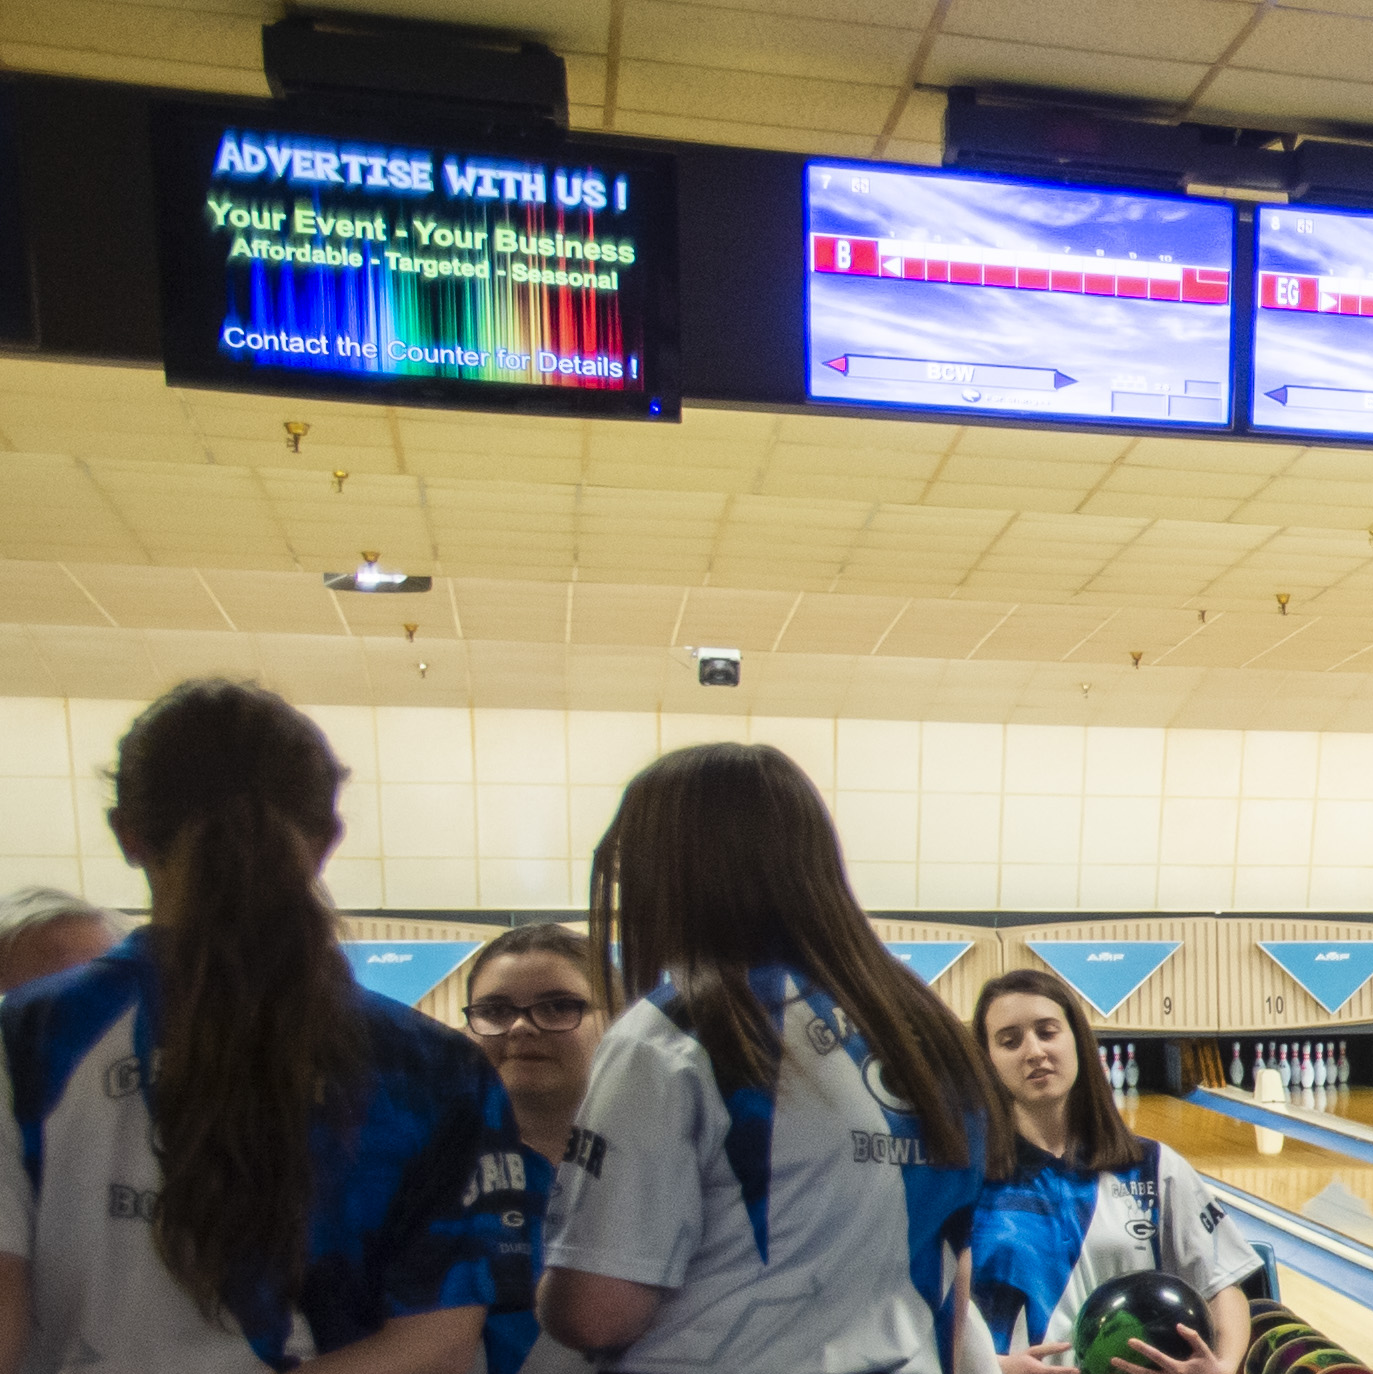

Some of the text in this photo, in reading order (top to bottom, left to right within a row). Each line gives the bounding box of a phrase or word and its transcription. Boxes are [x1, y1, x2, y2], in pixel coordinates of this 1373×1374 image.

[217, 140, 434, 192] ADVERTISE
[444, 163, 546, 203] WITH
[556, 176, 607, 209] US
[819, 173, 832, 190] 7
[208, 199, 286, 231] Your
[294, 207, 387, 242] Event
[413, 219, 487, 251] Your
[497, 228, 636, 265] Business
[231, 237, 363, 268] Affordable
[385, 252, 490, 280] Targeted
[512, 262, 619, 291] Seasonal
[837, 240, 852, 269] B
[1277, 277, 1299, 306] EG
[224, 326, 329, 357] Contact
[337, 335, 378, 360] the
[387, 340, 490, 369] Counter
[497, 346, 531, 371] for
[538, 350, 623, 380] Details
[926, 362, 976, 383] BCW
[1086, 952, 1125, 961] AMF
[1315, 950, 1350, 961] AMF
[1163, 996, 1173, 1015] 9
[1265, 995, 1284, 1015] 10
[851, 1130, 928, 1165] BOWL
